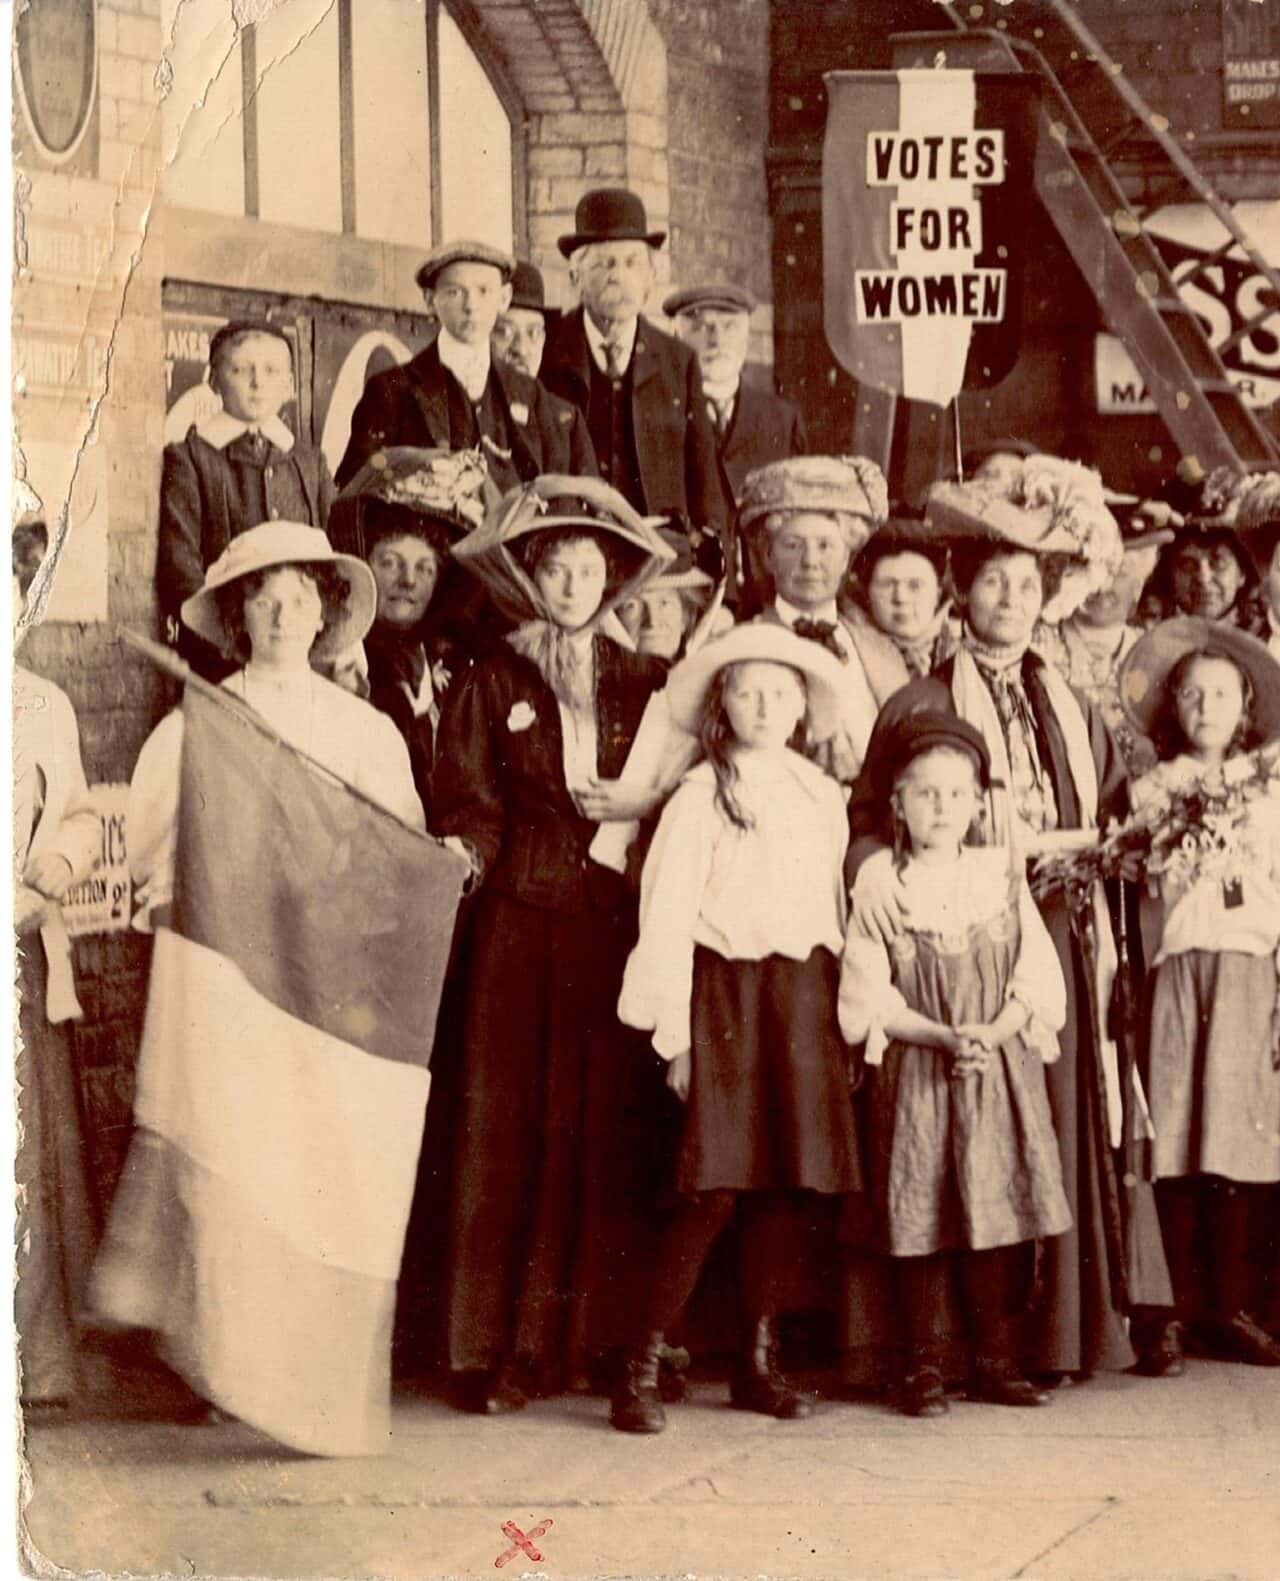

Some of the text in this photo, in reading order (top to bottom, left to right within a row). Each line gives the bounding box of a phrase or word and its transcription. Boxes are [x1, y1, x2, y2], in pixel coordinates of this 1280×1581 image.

[875, 137, 995, 180] VOTES
[897, 207, 971, 250] FOR
[861, 273, 1002, 319] WOMEN
